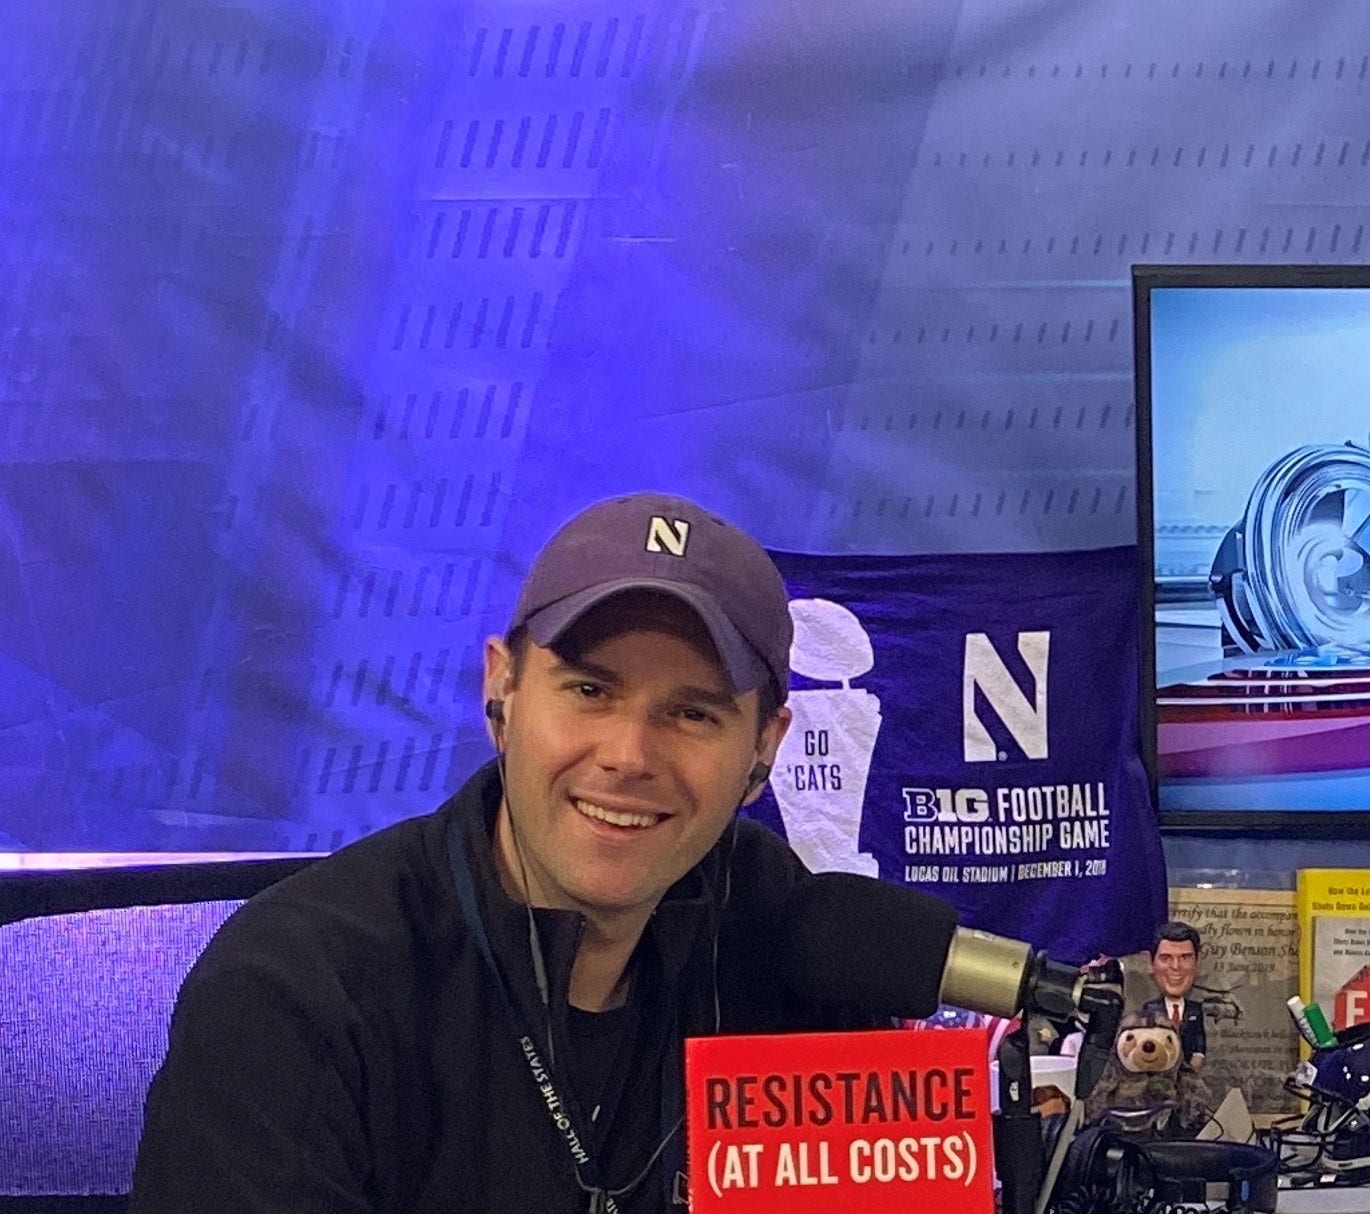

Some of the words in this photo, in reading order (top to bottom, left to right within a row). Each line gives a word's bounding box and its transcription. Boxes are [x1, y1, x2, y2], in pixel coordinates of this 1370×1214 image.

[645, 516, 689, 556] N
[963, 631, 1051, 762] N
[804, 729, 829, 757] GO
[996, 782, 1110, 823] FOOTBALL
[904, 823, 1053, 855] CHAMPIONSHIP
[1059, 819, 1110, 849] GAME
[905, 865, 939, 882] LUCAS
[941, 866, 959, 882] OIL
[962, 865, 1008, 883] STADIUM
[1017, 863, 1072, 881] DECEMBER
[705, 1068, 976, 1130] RESISTANCE
[707, 1140, 763, 1198] (AT
[775, 1141, 838, 1187] ALL
[850, 1131, 977, 1187] COSTS)
